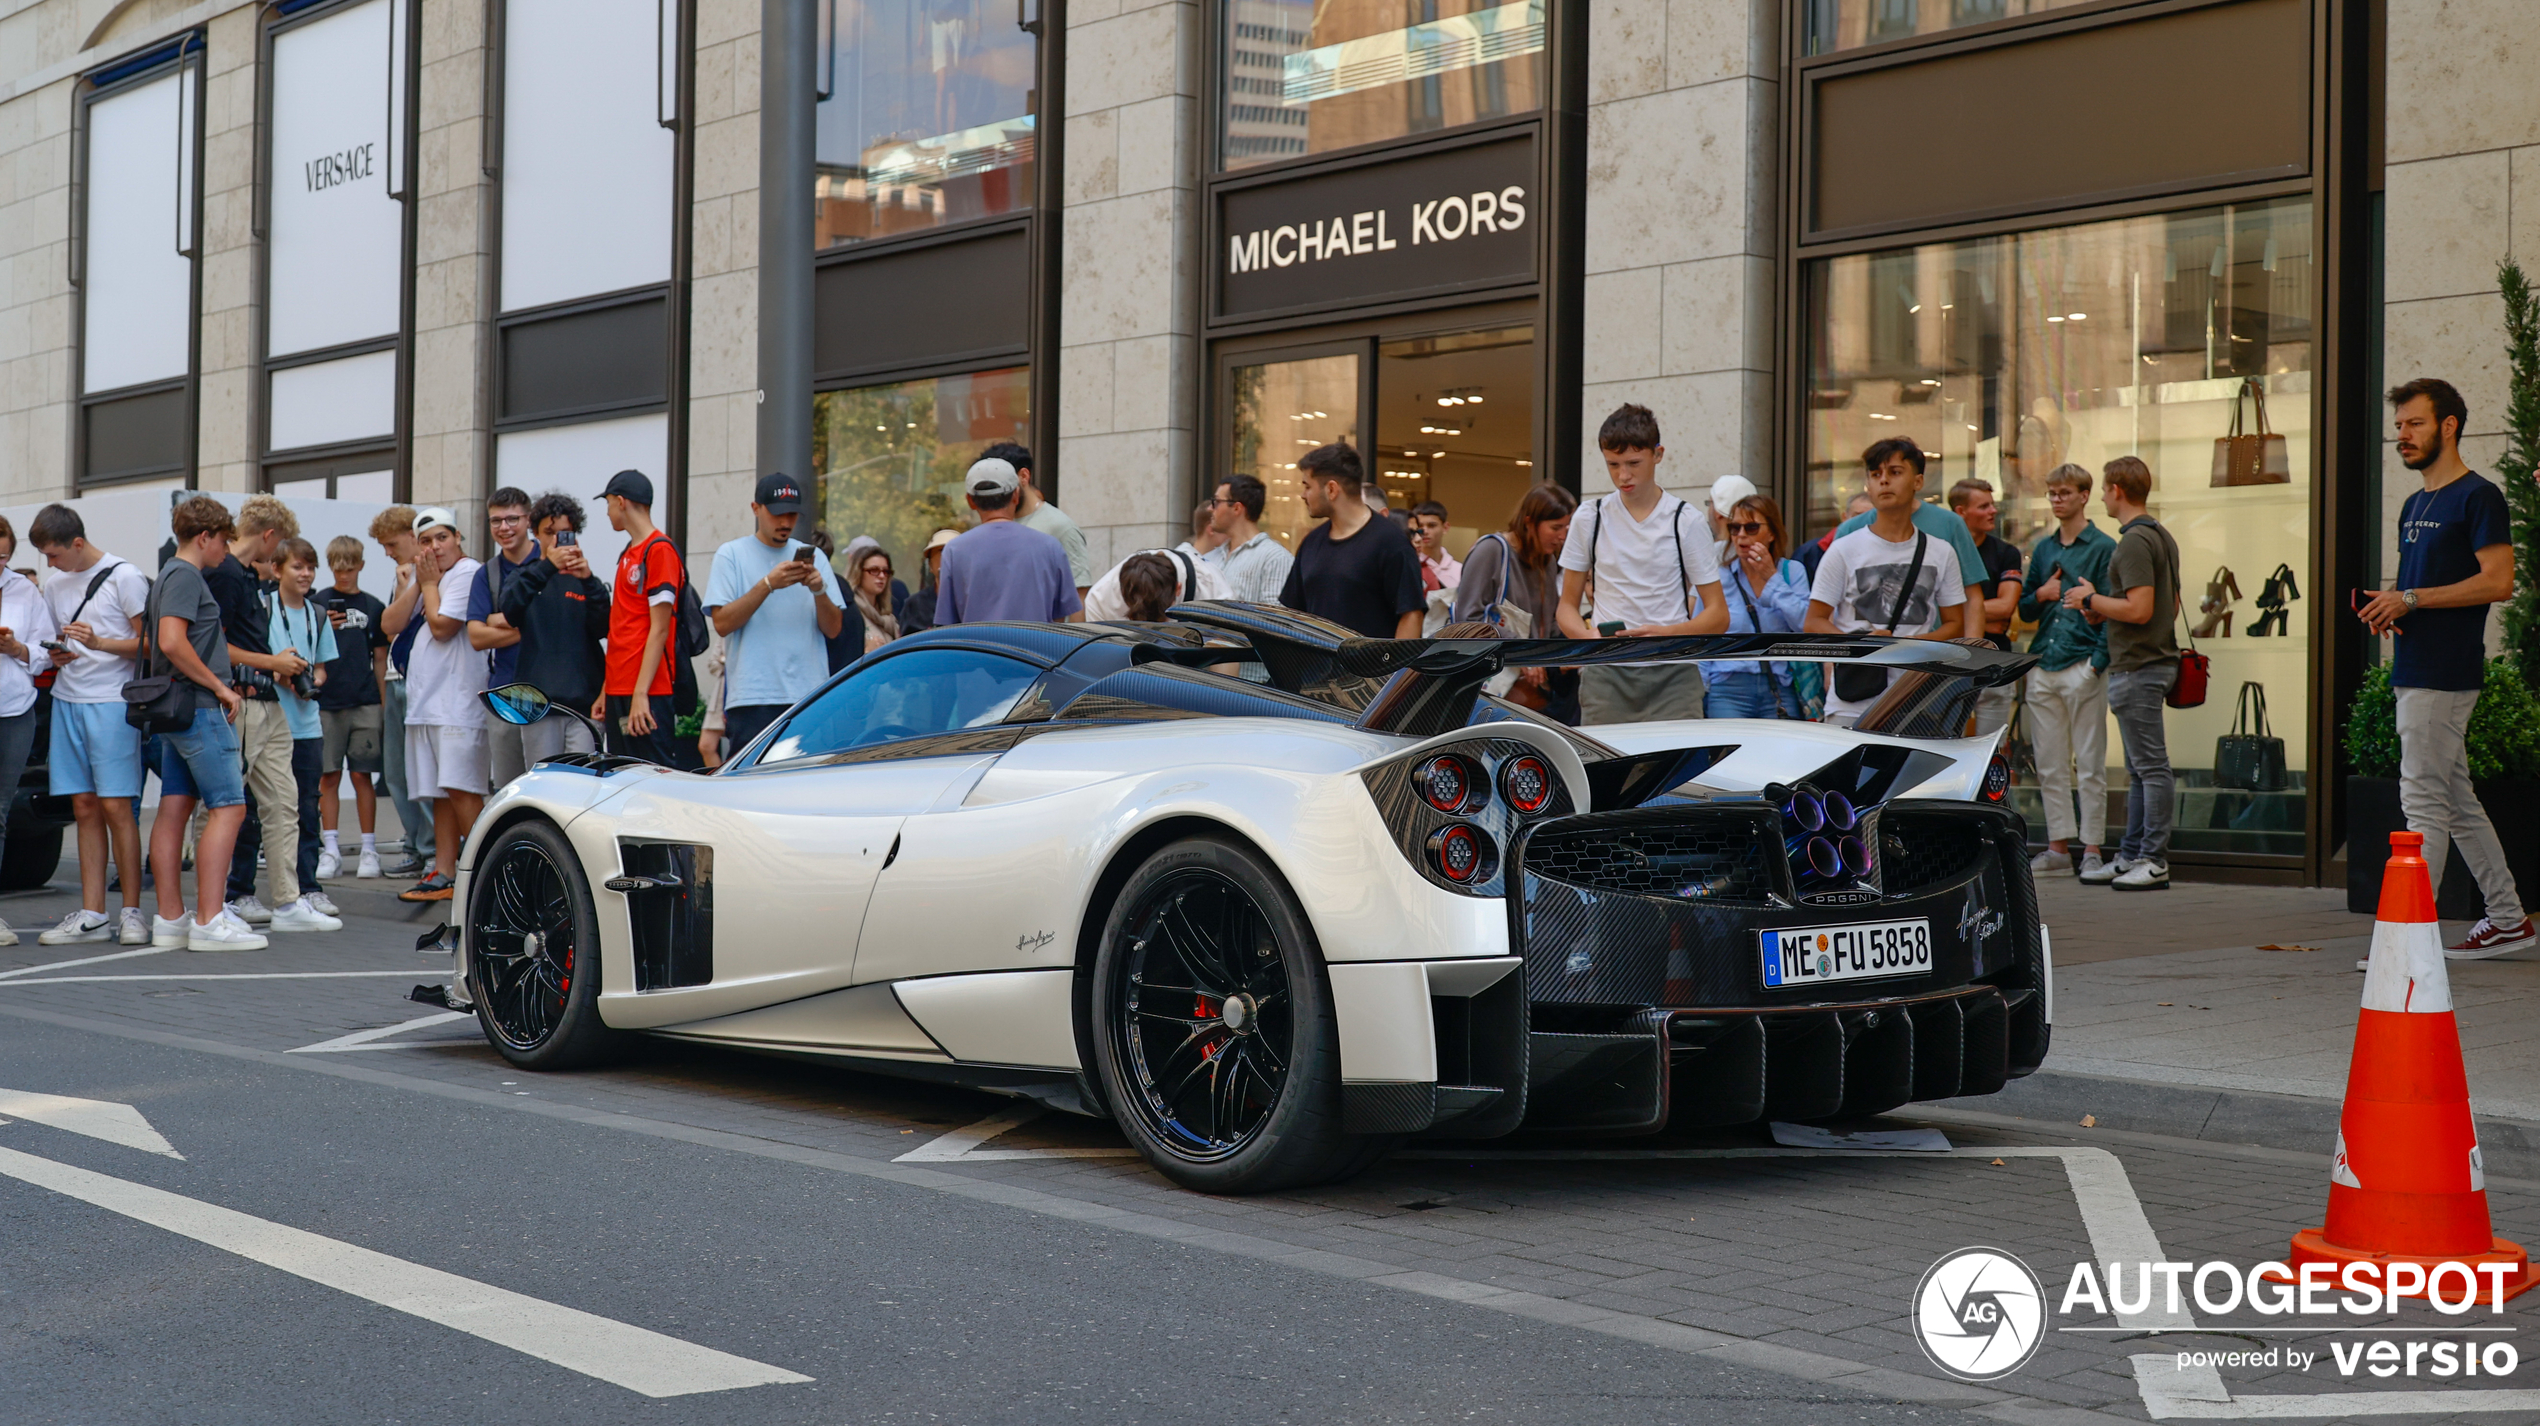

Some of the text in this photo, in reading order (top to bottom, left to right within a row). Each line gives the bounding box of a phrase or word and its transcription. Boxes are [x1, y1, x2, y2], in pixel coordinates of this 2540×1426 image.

[305, 143, 374, 192] VERSACE
[1230, 186, 1526, 274] MICHAEL KORS
[1816, 894, 1872, 904] PAGANI
[1769, 964, 1777, 977] D
[1782, 935, 1815, 978] ME
[1833, 931, 1865, 972] FU
[1870, 925, 1929, 969] 5858
